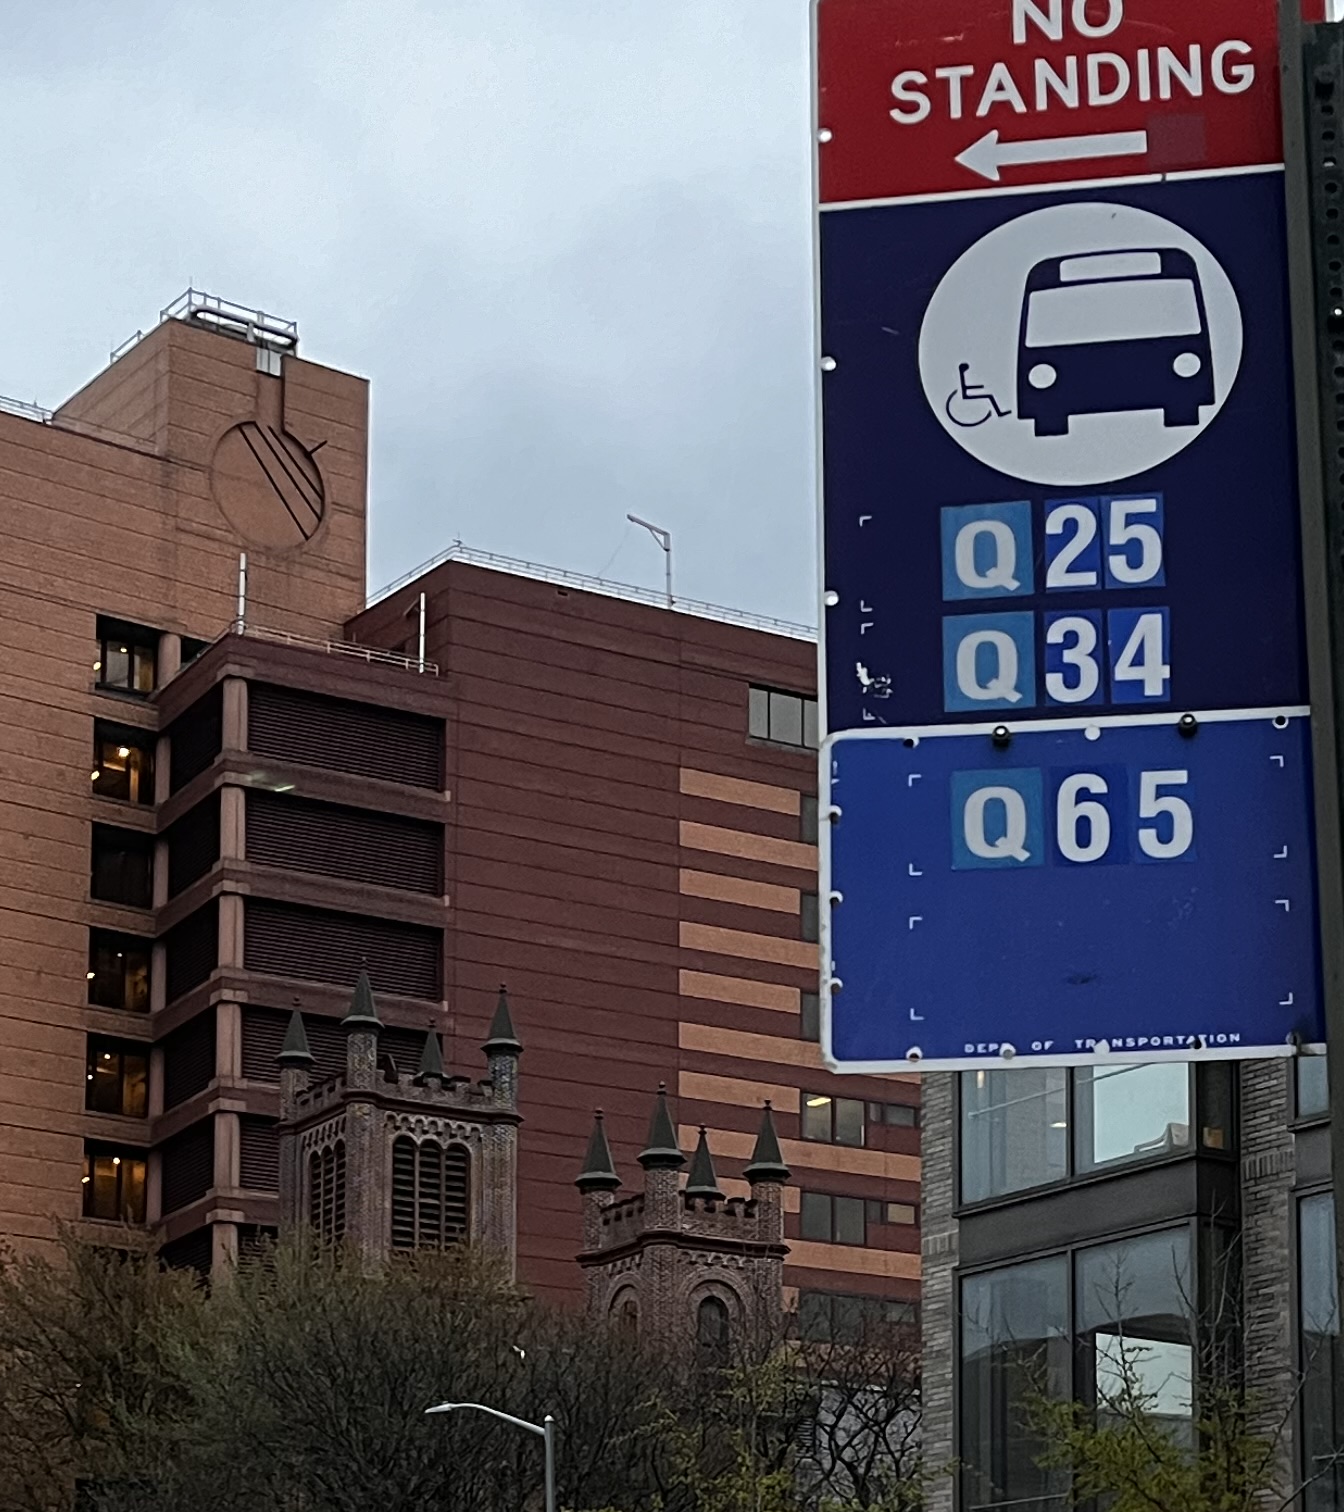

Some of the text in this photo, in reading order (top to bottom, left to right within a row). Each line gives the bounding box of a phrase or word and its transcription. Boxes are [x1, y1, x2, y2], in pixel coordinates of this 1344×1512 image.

[1013, 0, 1123, 44] NO
[889, 40, 1255, 125] STANDING
[964, 1033, 1241, 1054] DEP OF TRNSPORTATION
